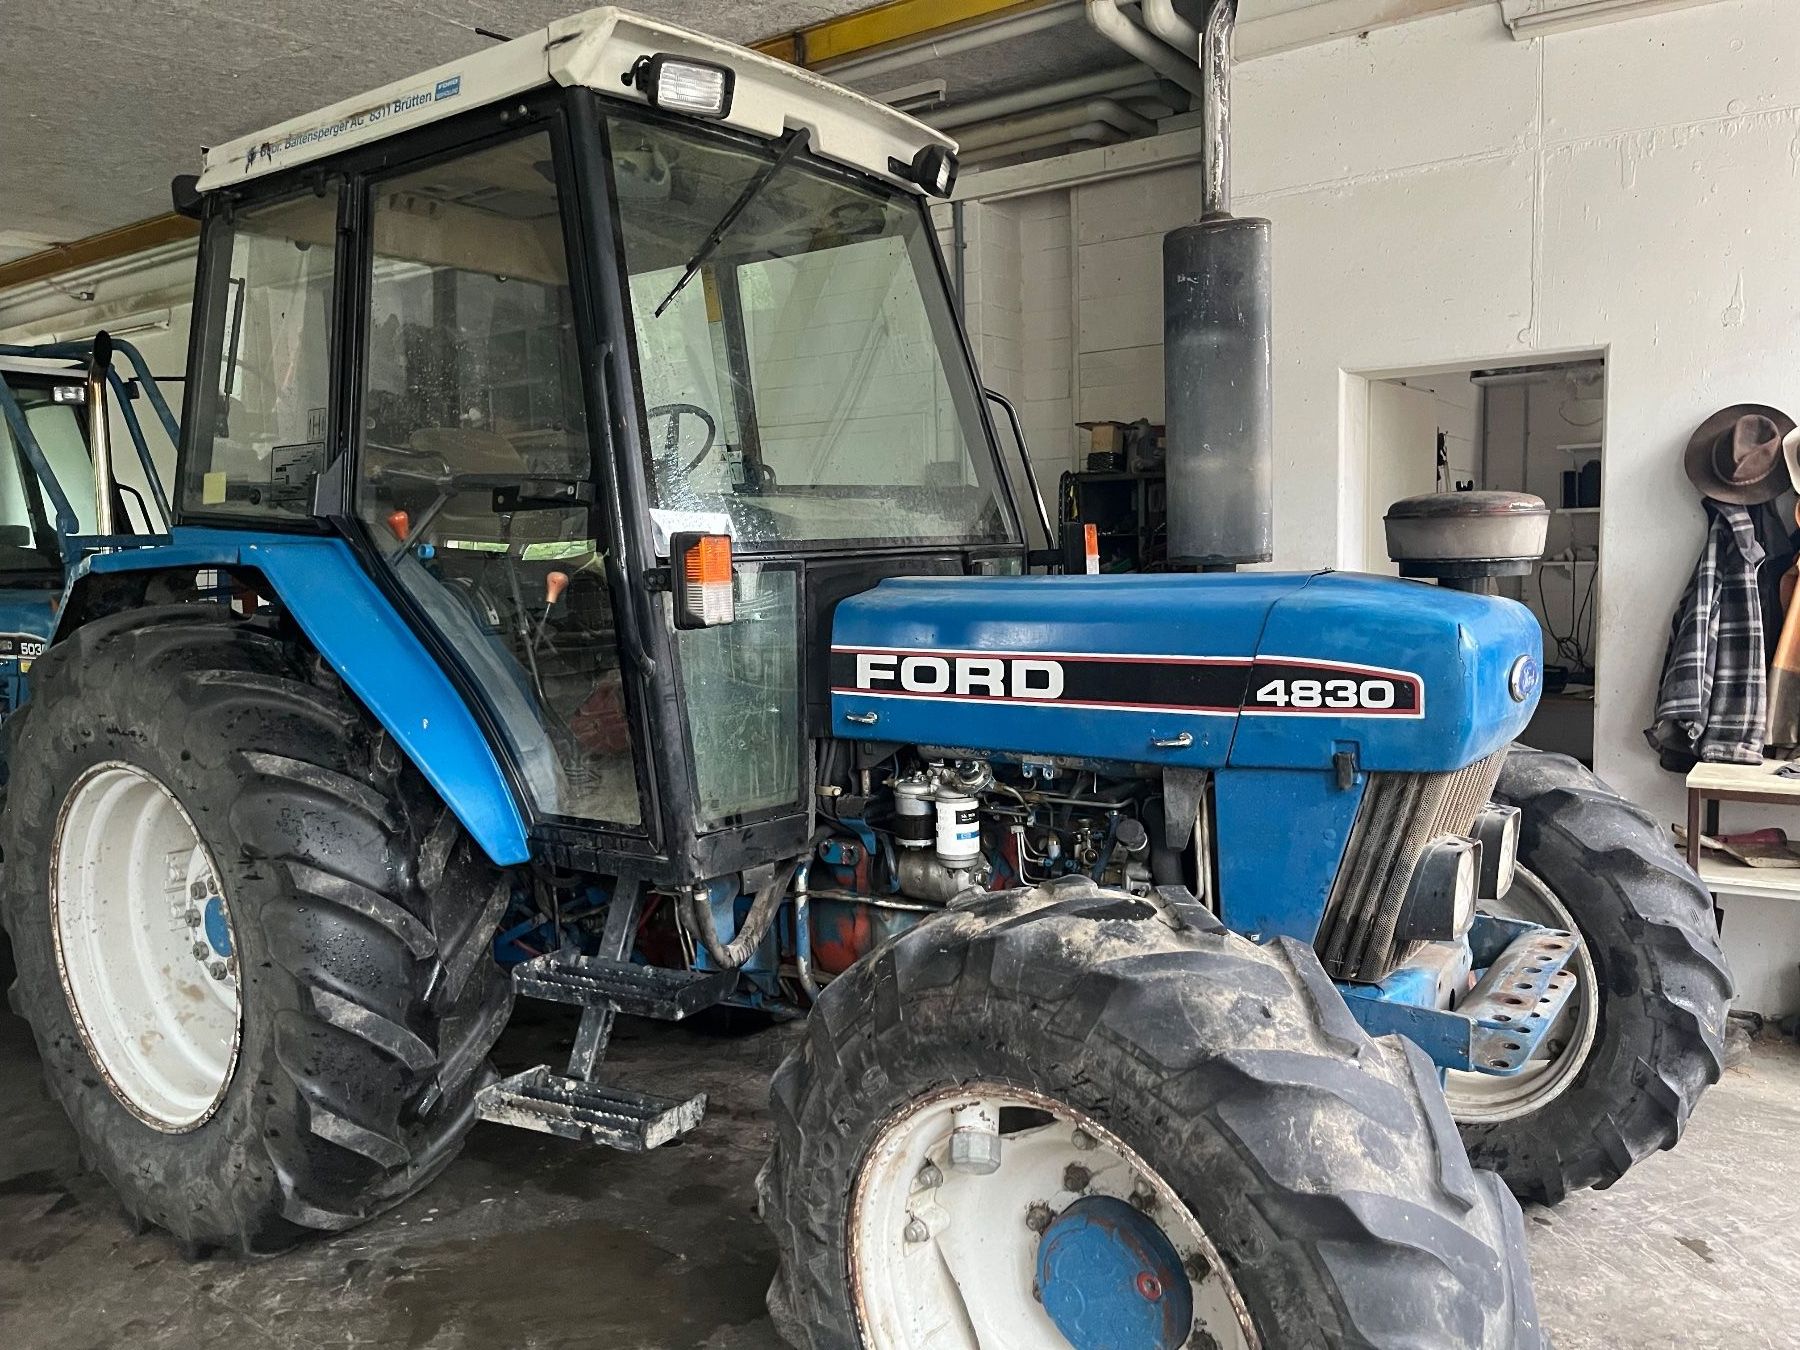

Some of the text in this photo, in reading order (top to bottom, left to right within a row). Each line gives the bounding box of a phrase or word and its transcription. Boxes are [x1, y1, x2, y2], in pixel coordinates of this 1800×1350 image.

[393, 91, 433, 113] Brütten
[857, 653, 1064, 699] FORD
[1256, 679, 1395, 709] 4830
